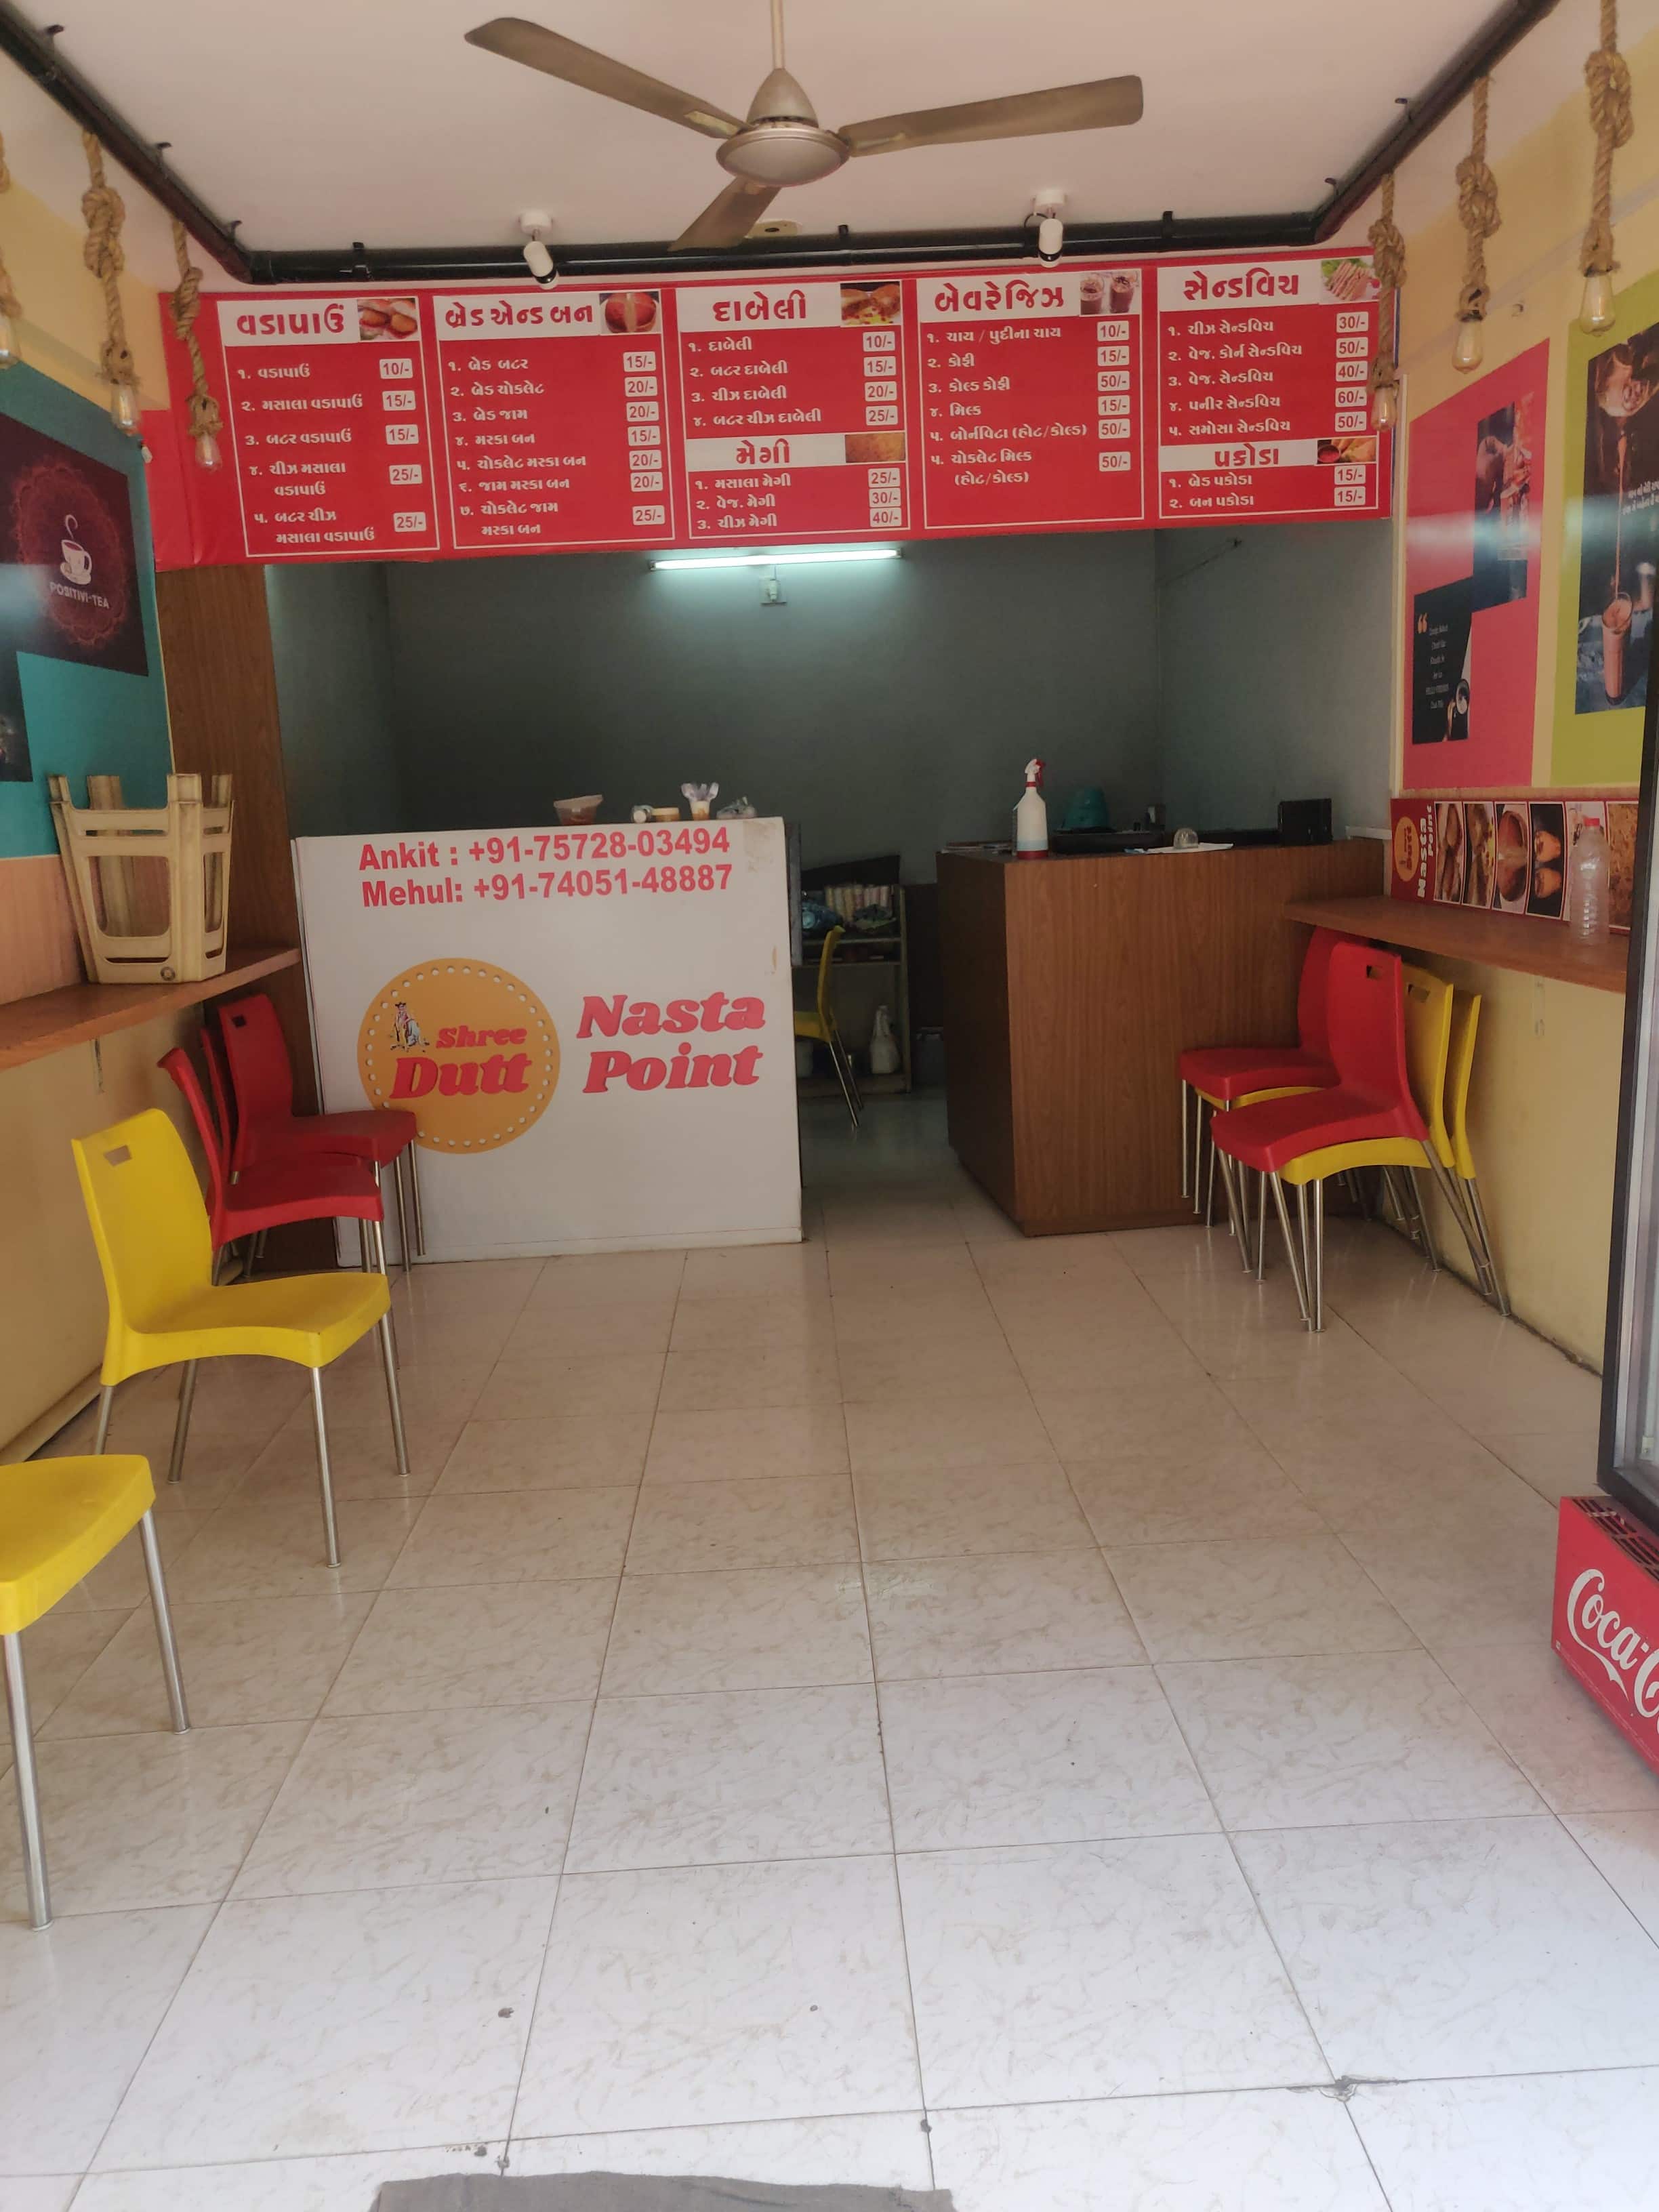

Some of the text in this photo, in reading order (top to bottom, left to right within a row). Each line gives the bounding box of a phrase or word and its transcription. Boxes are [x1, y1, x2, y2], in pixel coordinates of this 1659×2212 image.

[1184, 268, 1298, 300] સેન્ડવિચ
[935, 280, 1063, 312] બેવરેજિઝ
[713, 290, 806, 321] દાબેલી
[491, 300, 543, 325] એન્ડ
[550, 306, 592, 323] બન
[237, 304, 344, 335] વડાપાઉં
[1188, 321, 1216, 334] ચીઝ
[1219, 318, 1273, 333] સેન્ડવિચ
[1340, 316, 1365, 329] 30/-
[947, 332, 974, 342] ચાય
[990, 326, 1029, 344] પુદીના
[1034, 328, 1061, 337] ચાય
[1101, 325, 1126, 337] 10/-
[709, 336, 752, 351] દાબેલી
[867, 335, 892, 348] 10/-
[1339, 341, 1364, 354] 50/-
[1101, 350, 1126, 362] 15/-
[1248, 342, 1302, 357] સેન્ડવિચ
[498, 359, 528, 369] બટર
[627, 356, 652, 368] 15/-
[711, 366, 740, 375] બટર
[744, 360, 787, 375] દાબેલી
[867, 361, 893, 373] 15/-
[258, 363, 310, 378] વડાપાઉં
[384, 363, 409, 375] 10/-
[1338, 365, 1364, 377] 40/-
[1101, 375, 1126, 388] 50/-
[1220, 369, 1273, 384] સેન્ડવિચ
[628, 381, 653, 393] 20/-
[712, 388, 740, 401] ચીઝ
[743, 385, 786, 400] દાબેલી
[867, 386, 893, 398] 20/-
[262, 400, 307, 410] મસાલા
[311, 394, 363, 409] વડાપાઉં
[386, 394, 411, 407] 15/-
[1189, 396, 1223, 410] પનીર
[1227, 394, 1279, 409] સેન્ડવિચ
[1338, 390, 1364, 403] 60/-
[630, 406, 655, 417] 20/-
[1102, 399, 1126, 412] 15/-
[499, 410, 527, 419] જામ
[714, 415, 743, 425] બટર
[747, 411, 775, 424] ચીઝ
[779, 408, 821, 422] દાબેલી
[869, 410, 894, 422] 25/-
[1189, 421, 1233, 435] સમોસા
[1237, 418, 1290, 432] સેન્ડવિચ
[1338, 415, 1363, 428] 50/-
[390, 428, 415, 441] 15/-
[1102, 423, 1126, 435] 50/-
[266, 434, 296, 444] બટર
[300, 428, 351, 443] વડાપાઉં
[512, 434, 535, 443] બન
[632, 430, 656, 442] 15/-
[737, 438, 790, 464] મેગી
[1215, 443, 1278, 467] પકોડા
[563, 456, 586, 466] બન
[633, 454, 658, 466] 20/-
[1103, 455, 1127, 468] 50/-
[270, 461, 298, 474] ચીઝ
[302, 463, 346, 473] મસાલા
[392, 469, 418, 480] 25/-
[715, 478, 758, 489] મસાલા
[762, 473, 791, 487] મેગી
[872, 472, 897, 484] 25/-
[1214, 472, 1252, 485] પકોડા
[1338, 469, 1362, 480] 15/-
[274, 481, 325, 495] વડાપાઉં
[479, 481, 507, 491] જામ
[546, 479, 569, 488] બન
[634, 476, 659, 488] 20/-
[747, 493, 775, 507] મેગી
[873, 492, 897, 504] 30/-
[1189, 498, 1212, 507] બન
[1216, 493, 1254, 506] પકોડા
[1338, 490, 1362, 502] 15/-
[530, 503, 558, 512] જામ
[275, 512, 305, 522] બટર
[308, 508, 336, 521] ચીઝ
[636, 510, 661, 521] 25/-
[718, 515, 745, 528] ચીઝ
[749, 513, 777, 527] મેગી
[873, 512, 898, 523] 40/-
[397, 516, 422, 528] 25/-
[276, 527, 374, 544] મસાલા વડાપાઉં
[518, 525, 541, 534] બન
[359, 842, 439, 870] Ankit
[469, 827, 729, 863] +91-75728-03494
[363, 864, 732, 907] Mehul: +91-74051-48887
[576, 992, 765, 1038] Nasta
[436, 1025, 527, 1048] Shree
[583, 1042, 763, 1093] Point
[389, 1054, 531, 1099] Dutt
[1567, 1569, 1659, 1735] Coca-C
